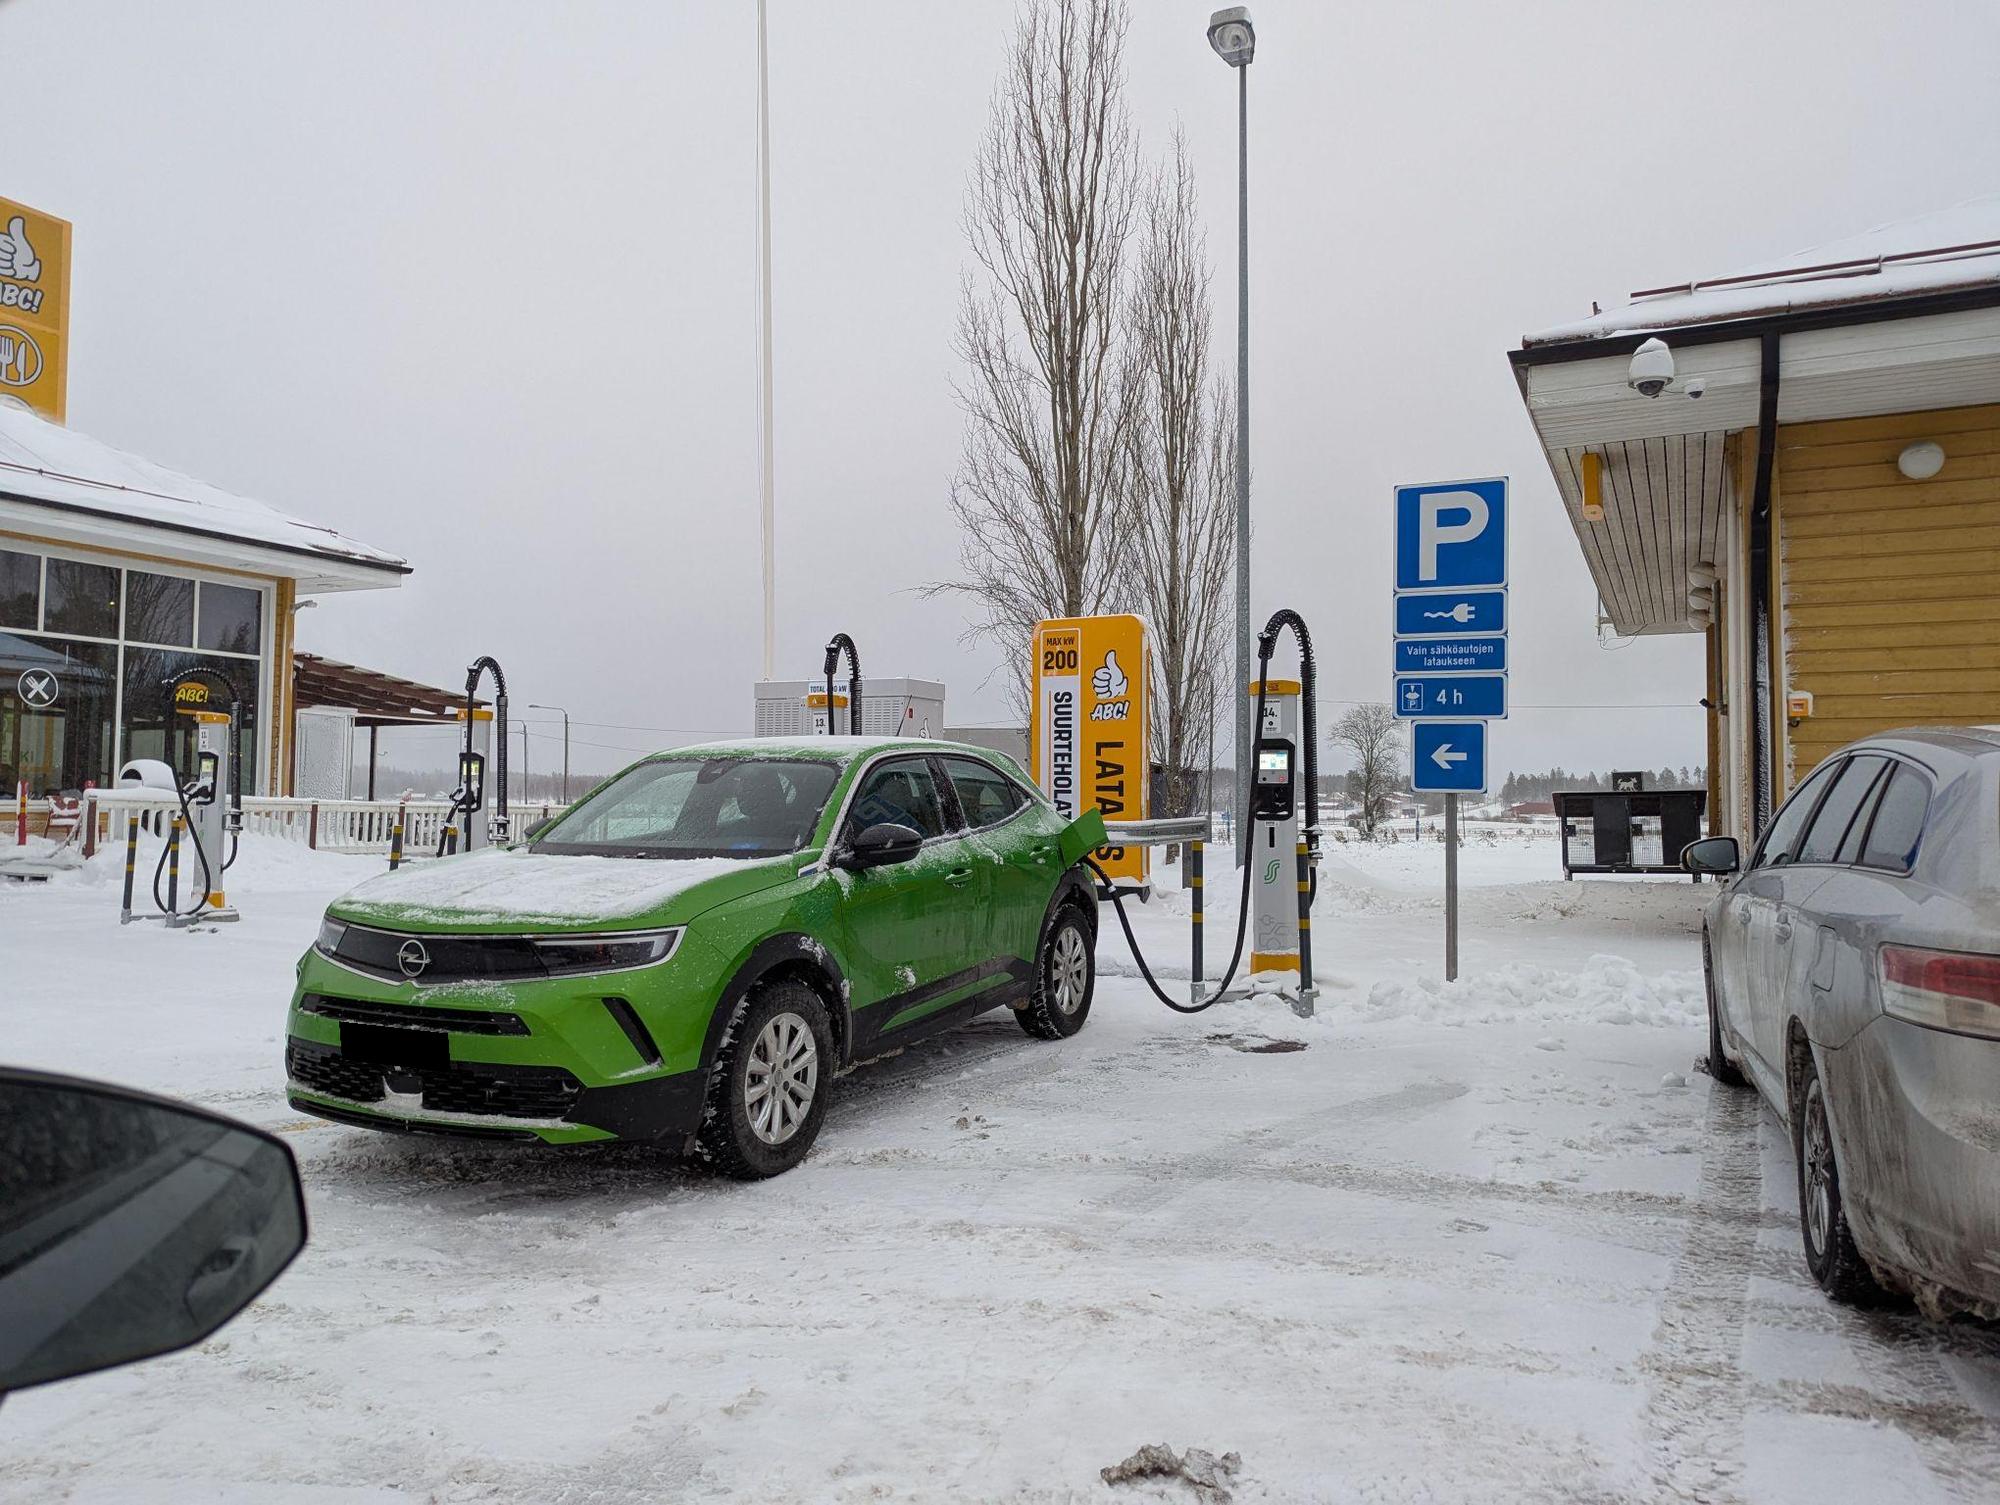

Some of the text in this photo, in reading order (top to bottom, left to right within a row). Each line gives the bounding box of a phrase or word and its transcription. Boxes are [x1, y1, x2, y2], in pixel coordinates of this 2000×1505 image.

[0, 281, 44, 315] BC!
[1418, 491, 1489, 581] P
[1046, 636, 1075, 646] MAX kW
[1406, 644, 1494, 656] Vain sähköautojen
[1044, 650, 1077, 670] 200
[1423, 656, 1476, 666] lataukseen
[175, 687, 209, 703] ABC!
[810, 685, 825, 693] TOTAL
[1436, 688, 1463, 705] 4 h
[1090, 699, 1131, 722] ABC!
[1095, 741, 1124, 862] LATAS
